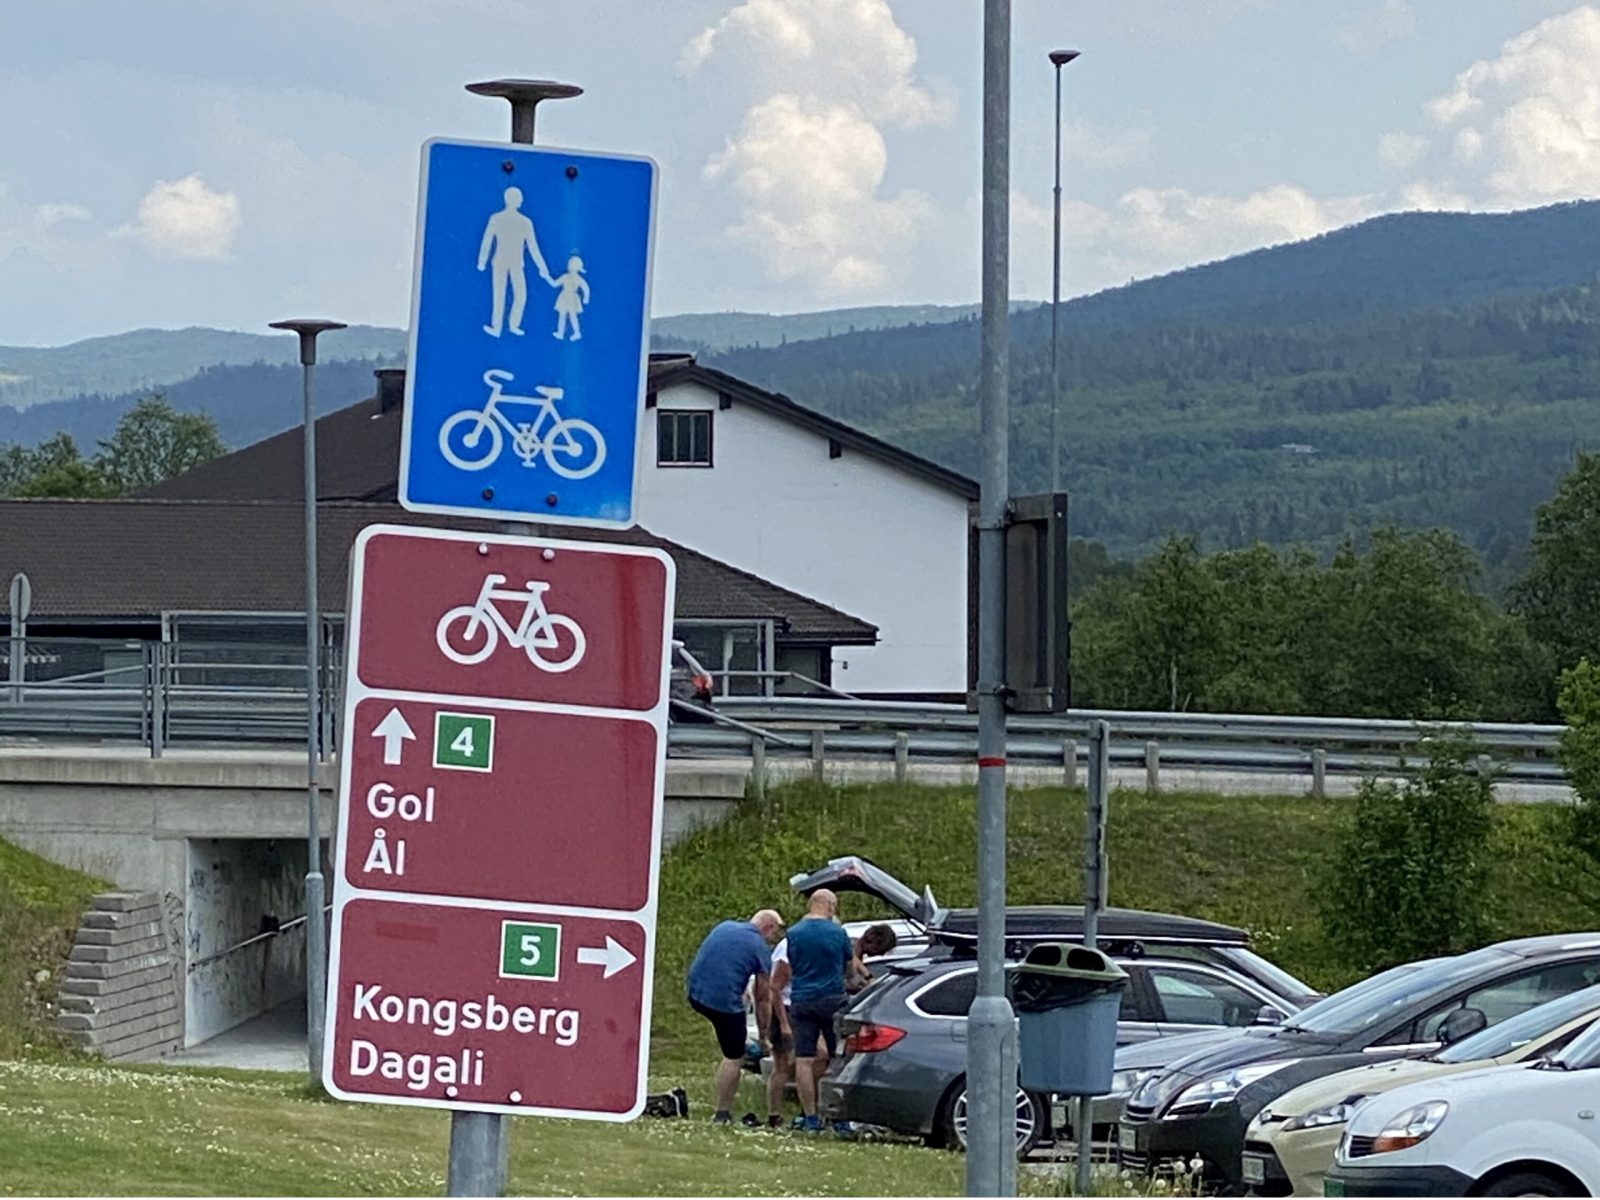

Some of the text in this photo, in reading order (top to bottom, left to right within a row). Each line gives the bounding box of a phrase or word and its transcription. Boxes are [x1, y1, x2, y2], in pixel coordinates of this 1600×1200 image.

[450, 726, 475, 758] 4
[366, 781, 436, 823] Gol
[363, 826, 406, 877] Ål
[519, 935, 541, 967] 5
[352, 983, 580, 1047] Kongsberg
[350, 1038, 484, 1091] Dagali
